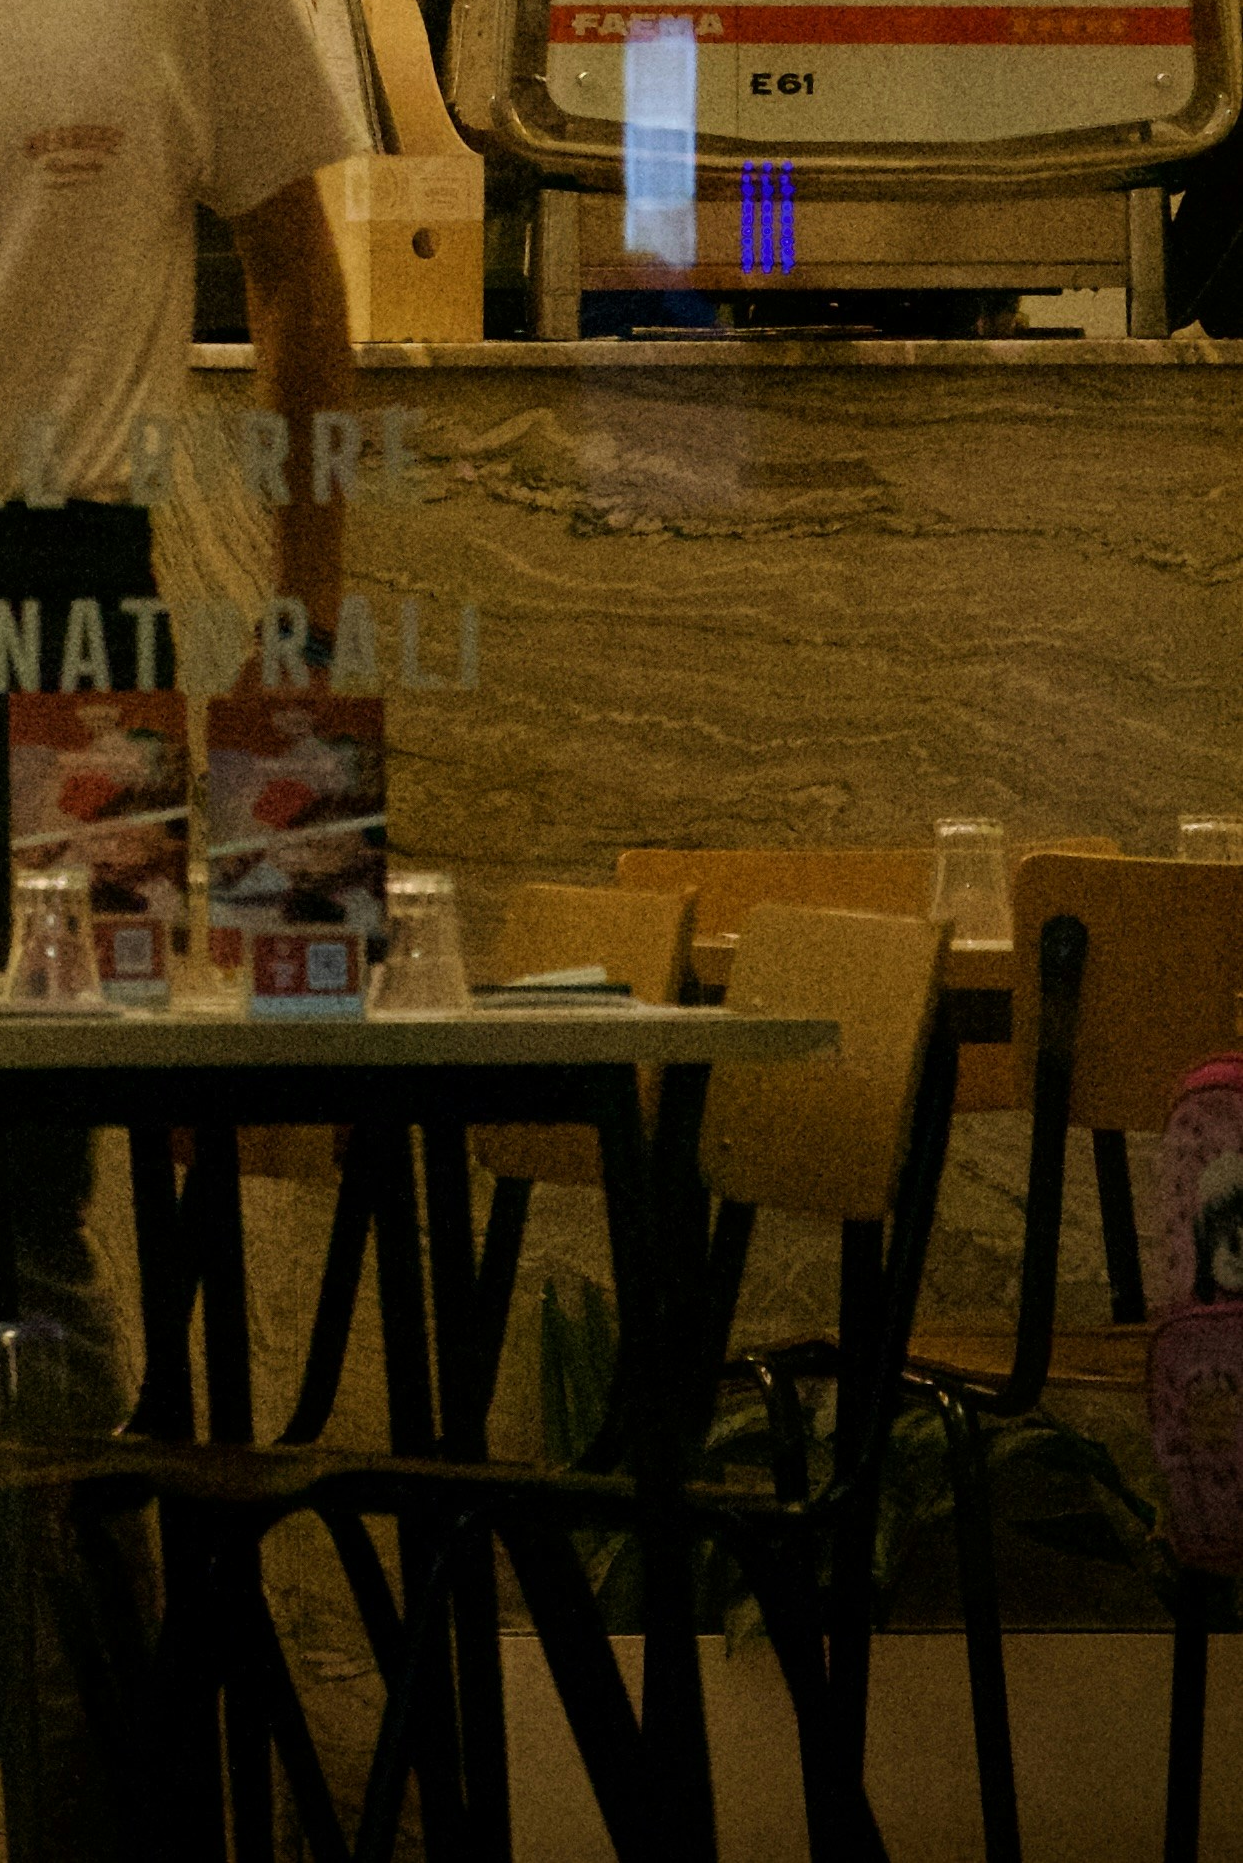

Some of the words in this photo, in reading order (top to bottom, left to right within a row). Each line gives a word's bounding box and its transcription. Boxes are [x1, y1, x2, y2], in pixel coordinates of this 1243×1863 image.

[571, 11, 725, 38] FAEMA
[751, 72, 814, 96] E61
[130, 401, 426, 509] BRRE
